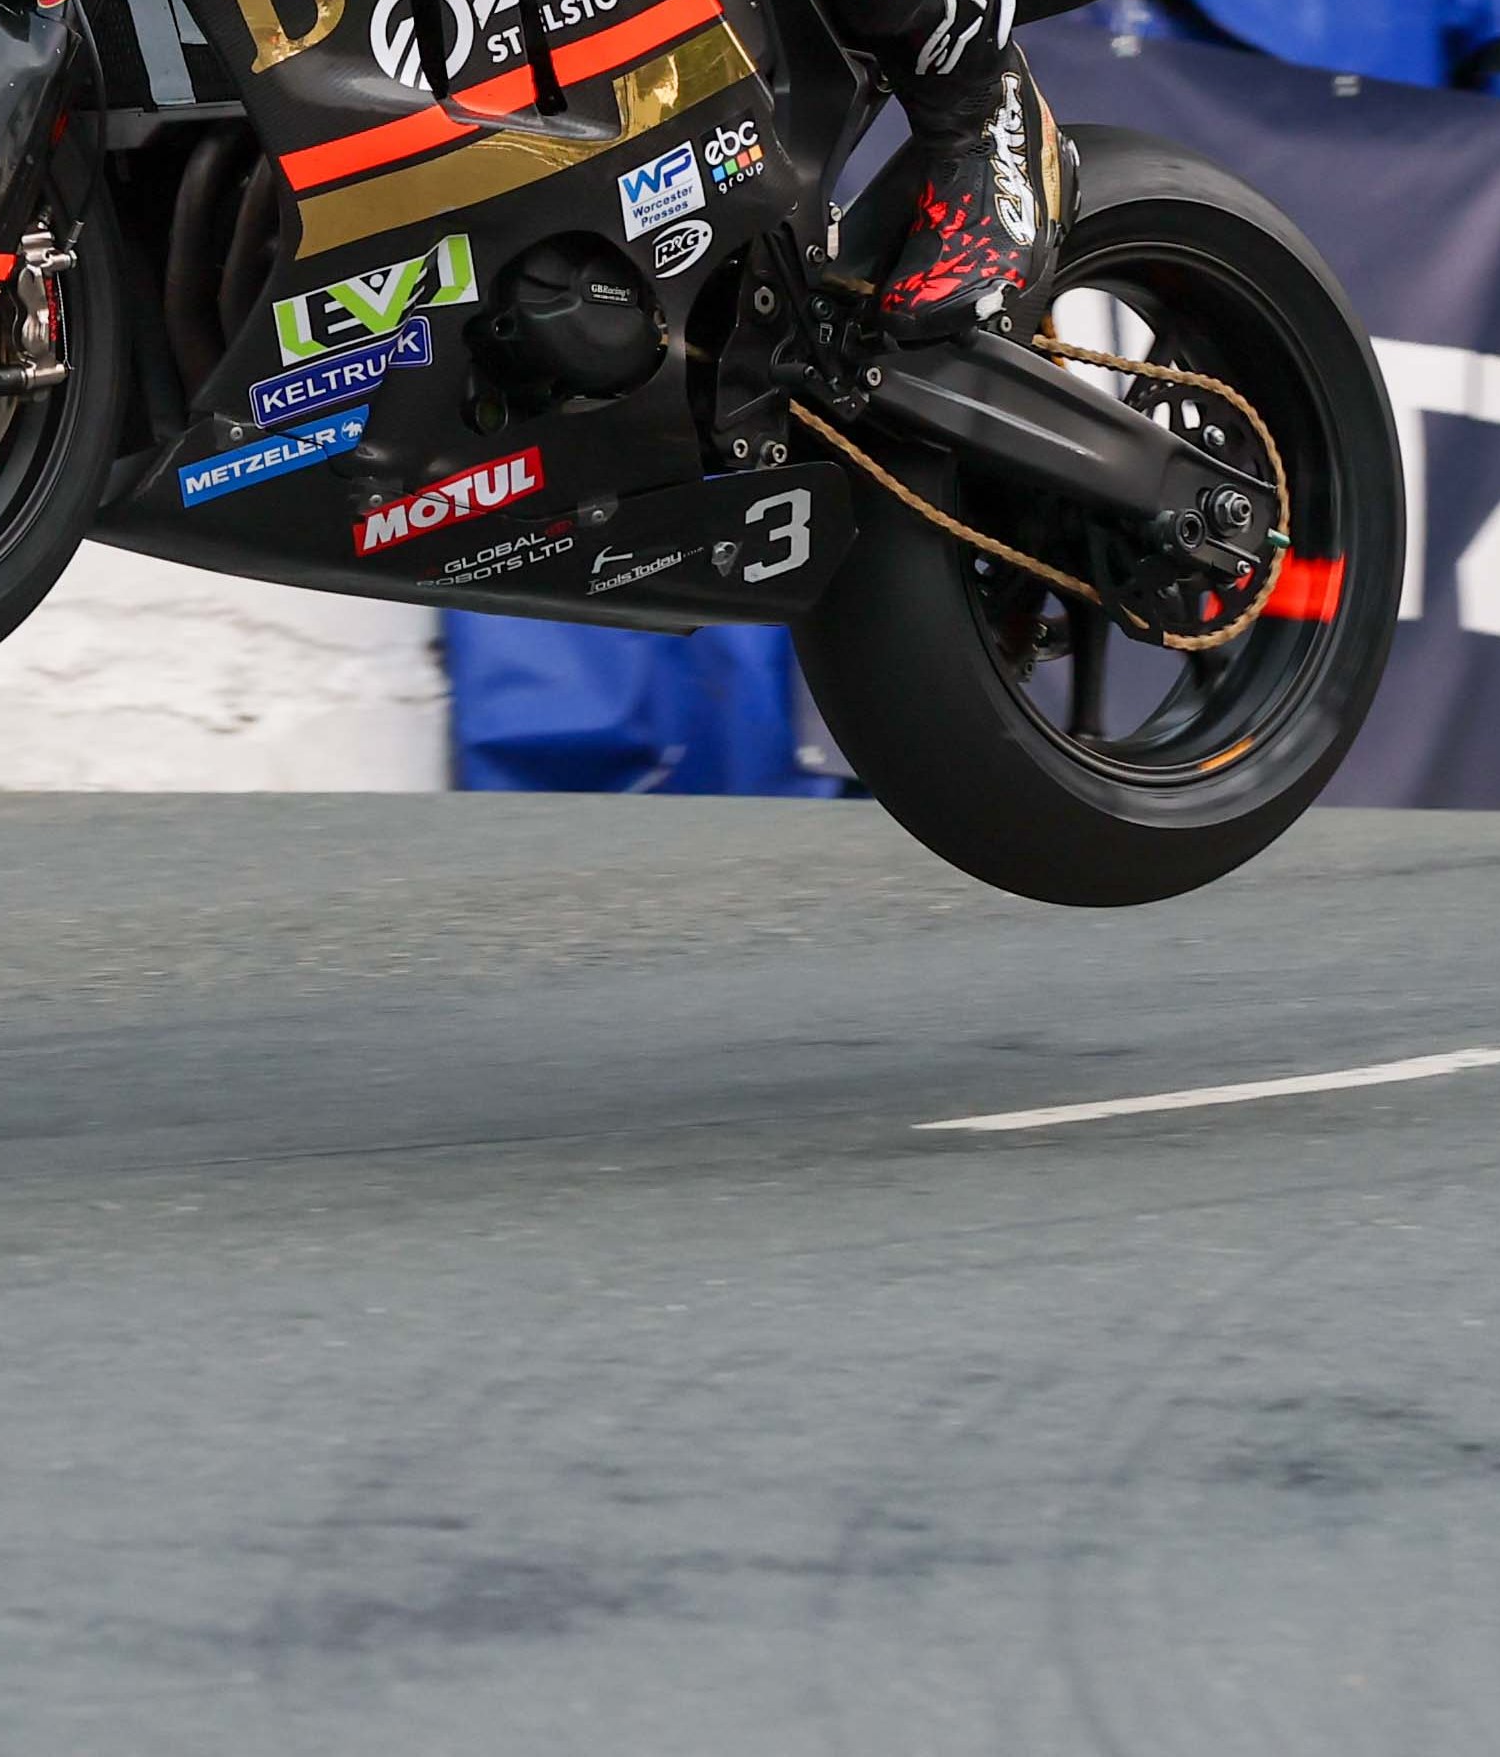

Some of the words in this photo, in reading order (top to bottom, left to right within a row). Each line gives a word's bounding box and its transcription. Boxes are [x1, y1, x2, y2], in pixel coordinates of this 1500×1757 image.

[704, 120, 759, 166] ebc
[718, 161, 765, 195] group
[632, 184, 694, 220] Worcester
[640, 198, 689, 228] Presses
[655, 226, 700, 269] R&G
[261, 330, 421, 414] KELTRUK
[185, 427, 337, 494] METZELER
[362, 456, 537, 549] MOTUL
[443, 532, 547, 574] GLOBAL
[528, 536, 574, 563] LTD
[743, 487, 812, 584] 3
